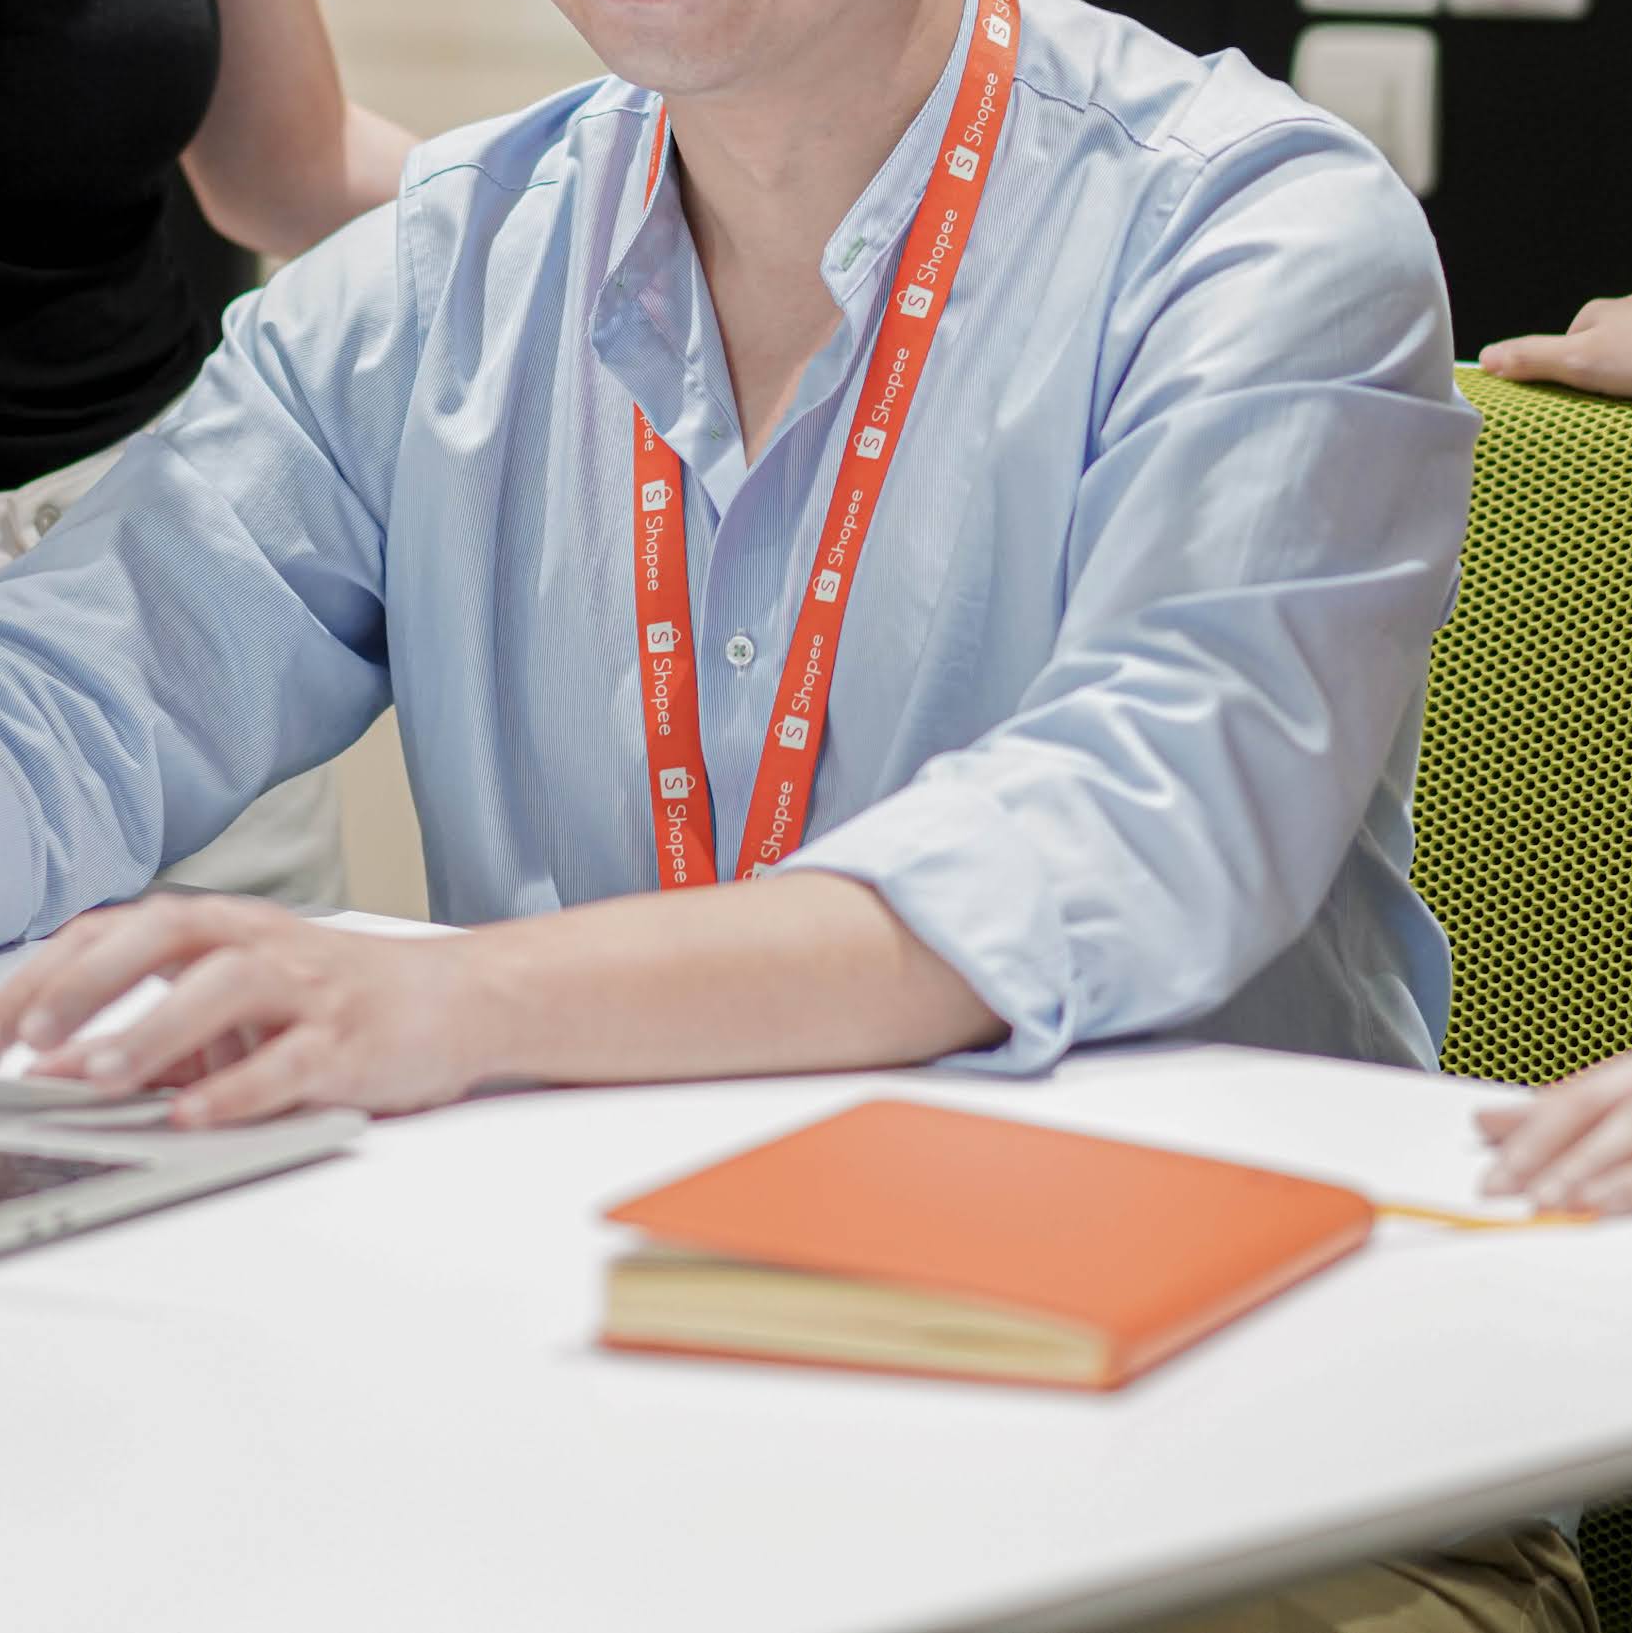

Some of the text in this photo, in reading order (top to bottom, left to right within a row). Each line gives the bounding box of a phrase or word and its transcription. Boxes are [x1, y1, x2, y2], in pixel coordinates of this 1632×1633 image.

[964, 72, 999, 147] Shopee
[917, 209, 958, 284] Shopee
[871, 348, 910, 425] Shopee
[642, 516, 663, 591] Shopee
[828, 489, 864, 567] Shopee
[650, 658, 672, 736] Shopee
[792, 634, 825, 713] Shopee
[666, 804, 688, 883] Shopee
[760, 780, 795, 860] Shopee
